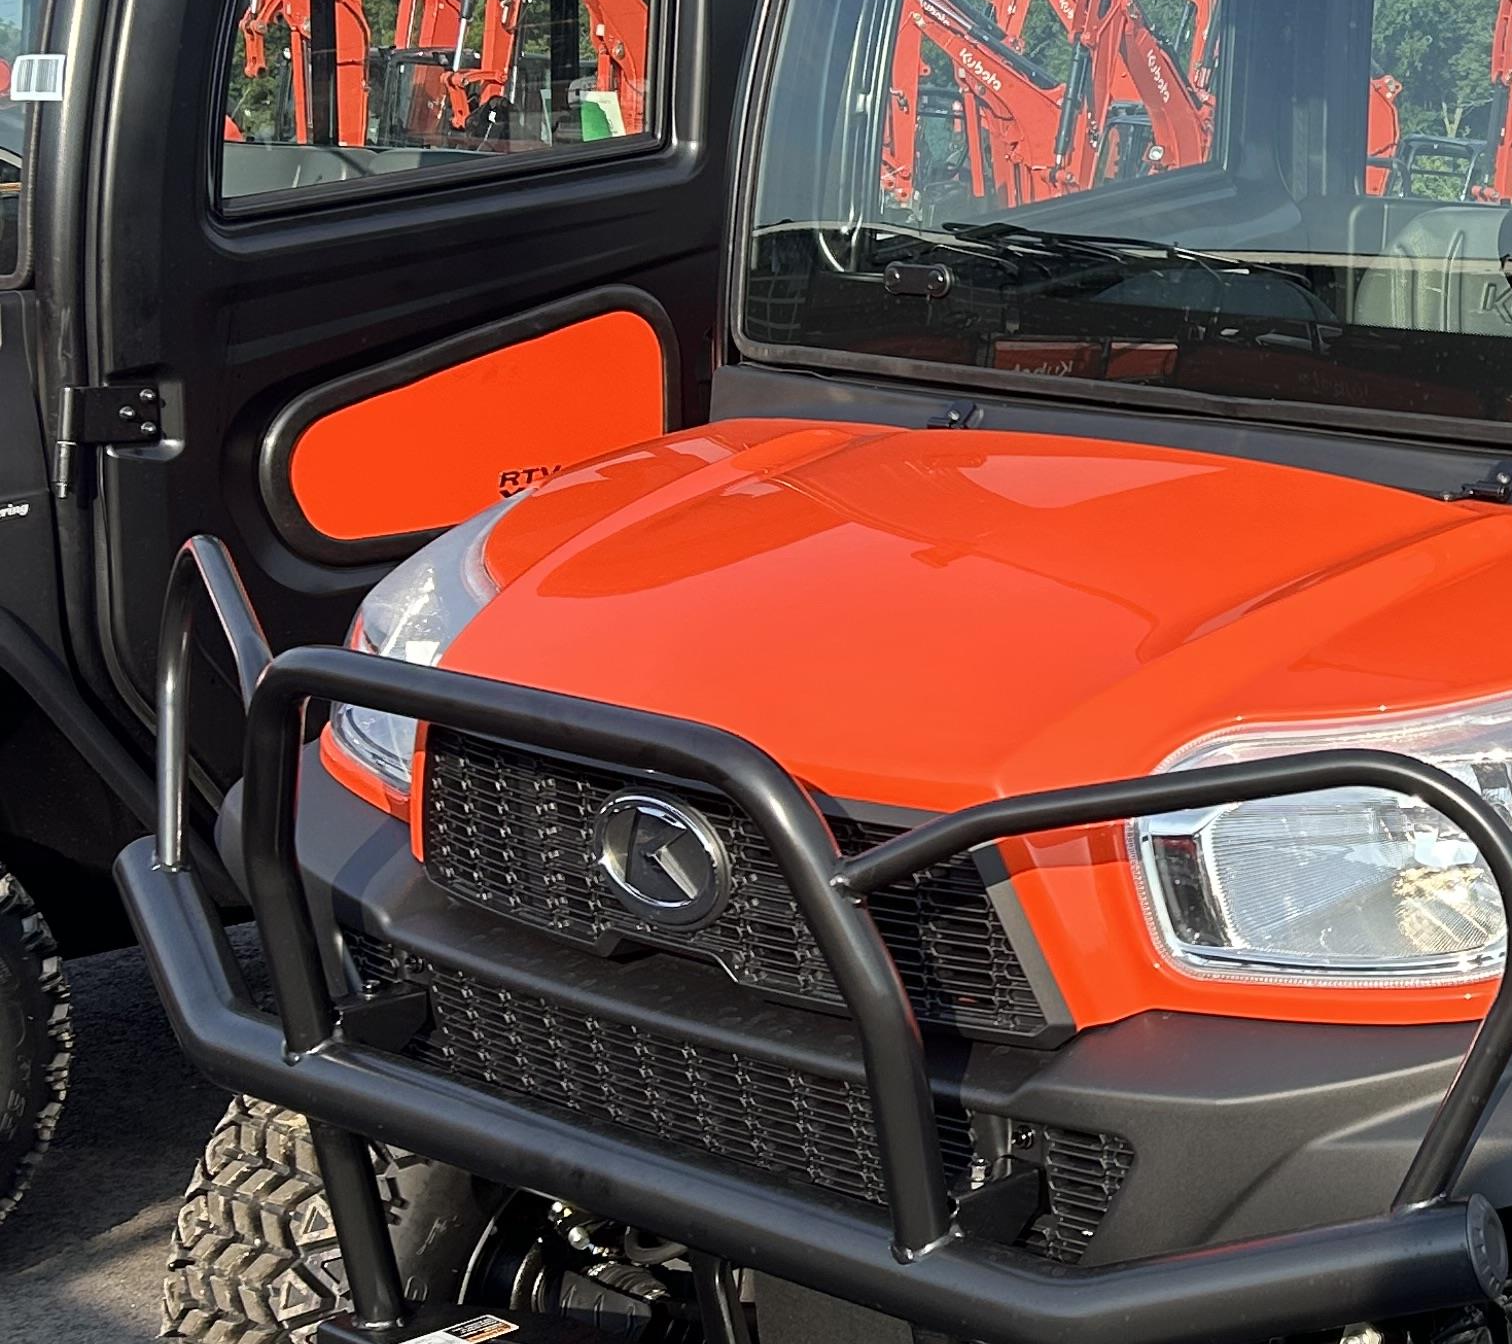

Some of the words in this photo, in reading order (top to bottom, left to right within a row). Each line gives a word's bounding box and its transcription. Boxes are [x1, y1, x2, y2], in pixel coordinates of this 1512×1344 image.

[958, 48, 1003, 92] Kubota
[1147, 48, 1170, 105] Kubota
[499, 464, 561, 488] RTV
